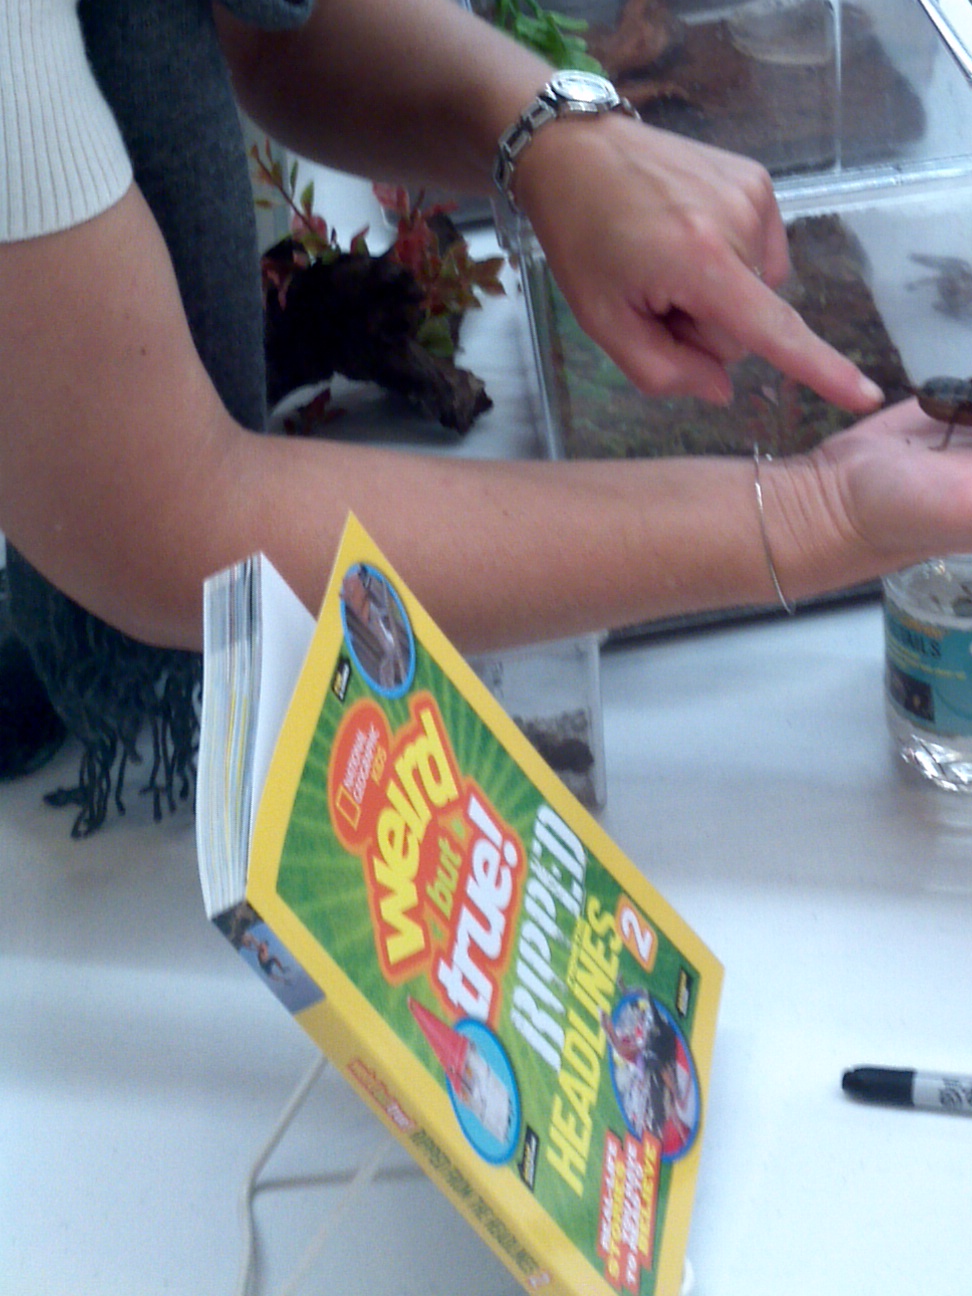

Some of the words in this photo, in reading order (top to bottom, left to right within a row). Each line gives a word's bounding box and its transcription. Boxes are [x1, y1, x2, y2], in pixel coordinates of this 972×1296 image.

[343, 727, 367, 788] NATIONAL
[352, 722, 380, 804] GEOGRAPHIC
[370, 743, 388, 787] KIDS
[373, 707, 460, 966] weird
[425, 835, 463, 921] but
[437, 792, 519, 1024] true!
[510, 803, 588, 1075] RIPPED
[619, 906, 655, 965] 2
[546, 895, 624, 1199] HEADLINES
[600, 1138, 618, 1253] REAL-LIFE
[608, 1160, 627, 1282] STORIES
[637, 1139, 658, 1255] BELIEVE
[627, 1248, 643, 1283] TO
